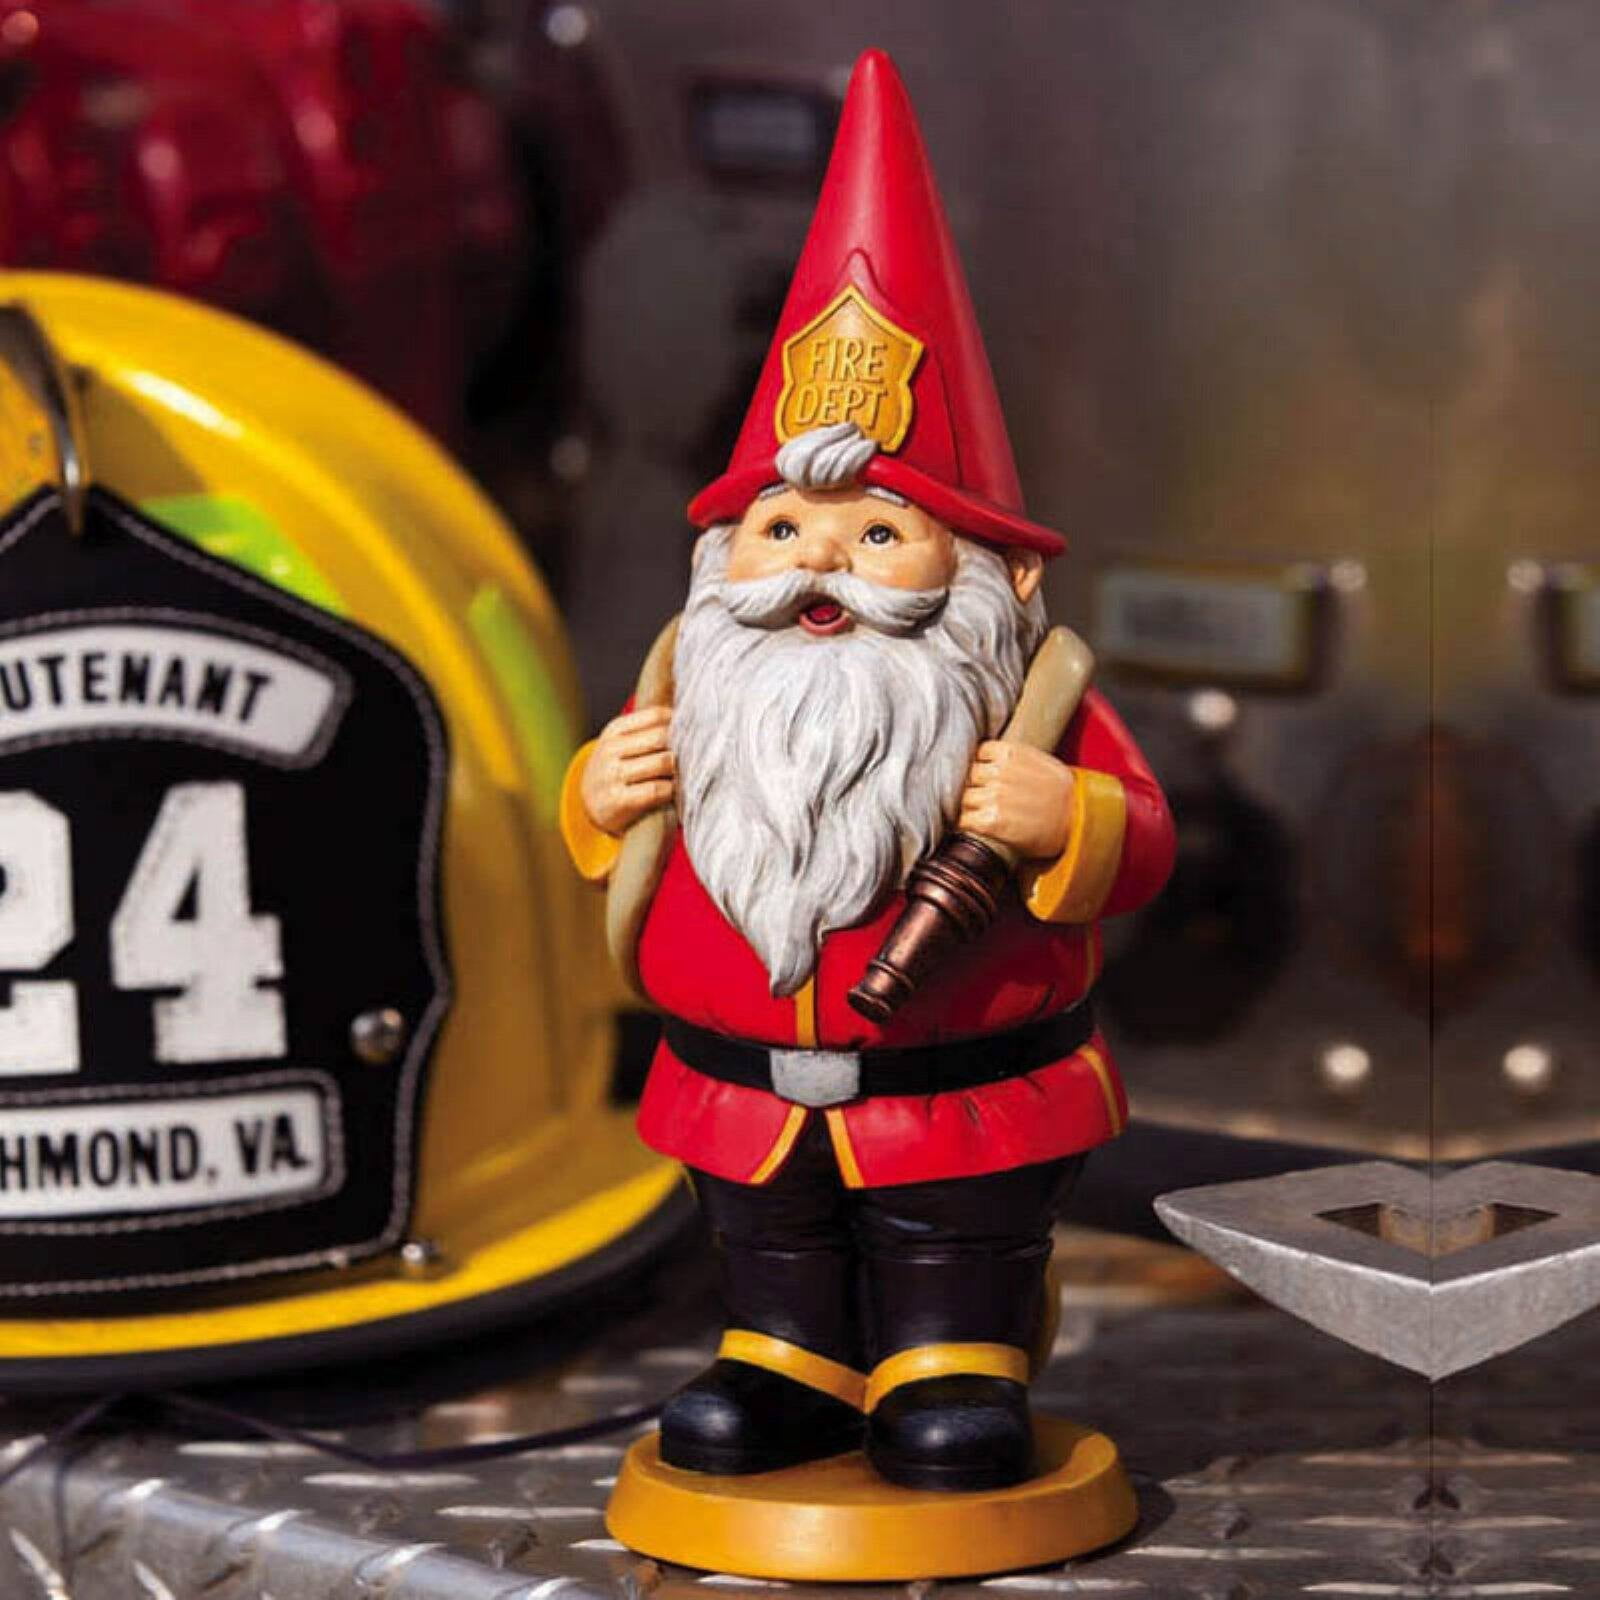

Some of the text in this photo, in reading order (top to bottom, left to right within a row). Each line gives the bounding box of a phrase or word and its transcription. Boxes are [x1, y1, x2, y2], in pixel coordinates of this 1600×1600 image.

[810, 337, 888, 383] FIRE
[794, 381, 889, 431] DEPT
[0, 653, 271, 722] UTENANT
